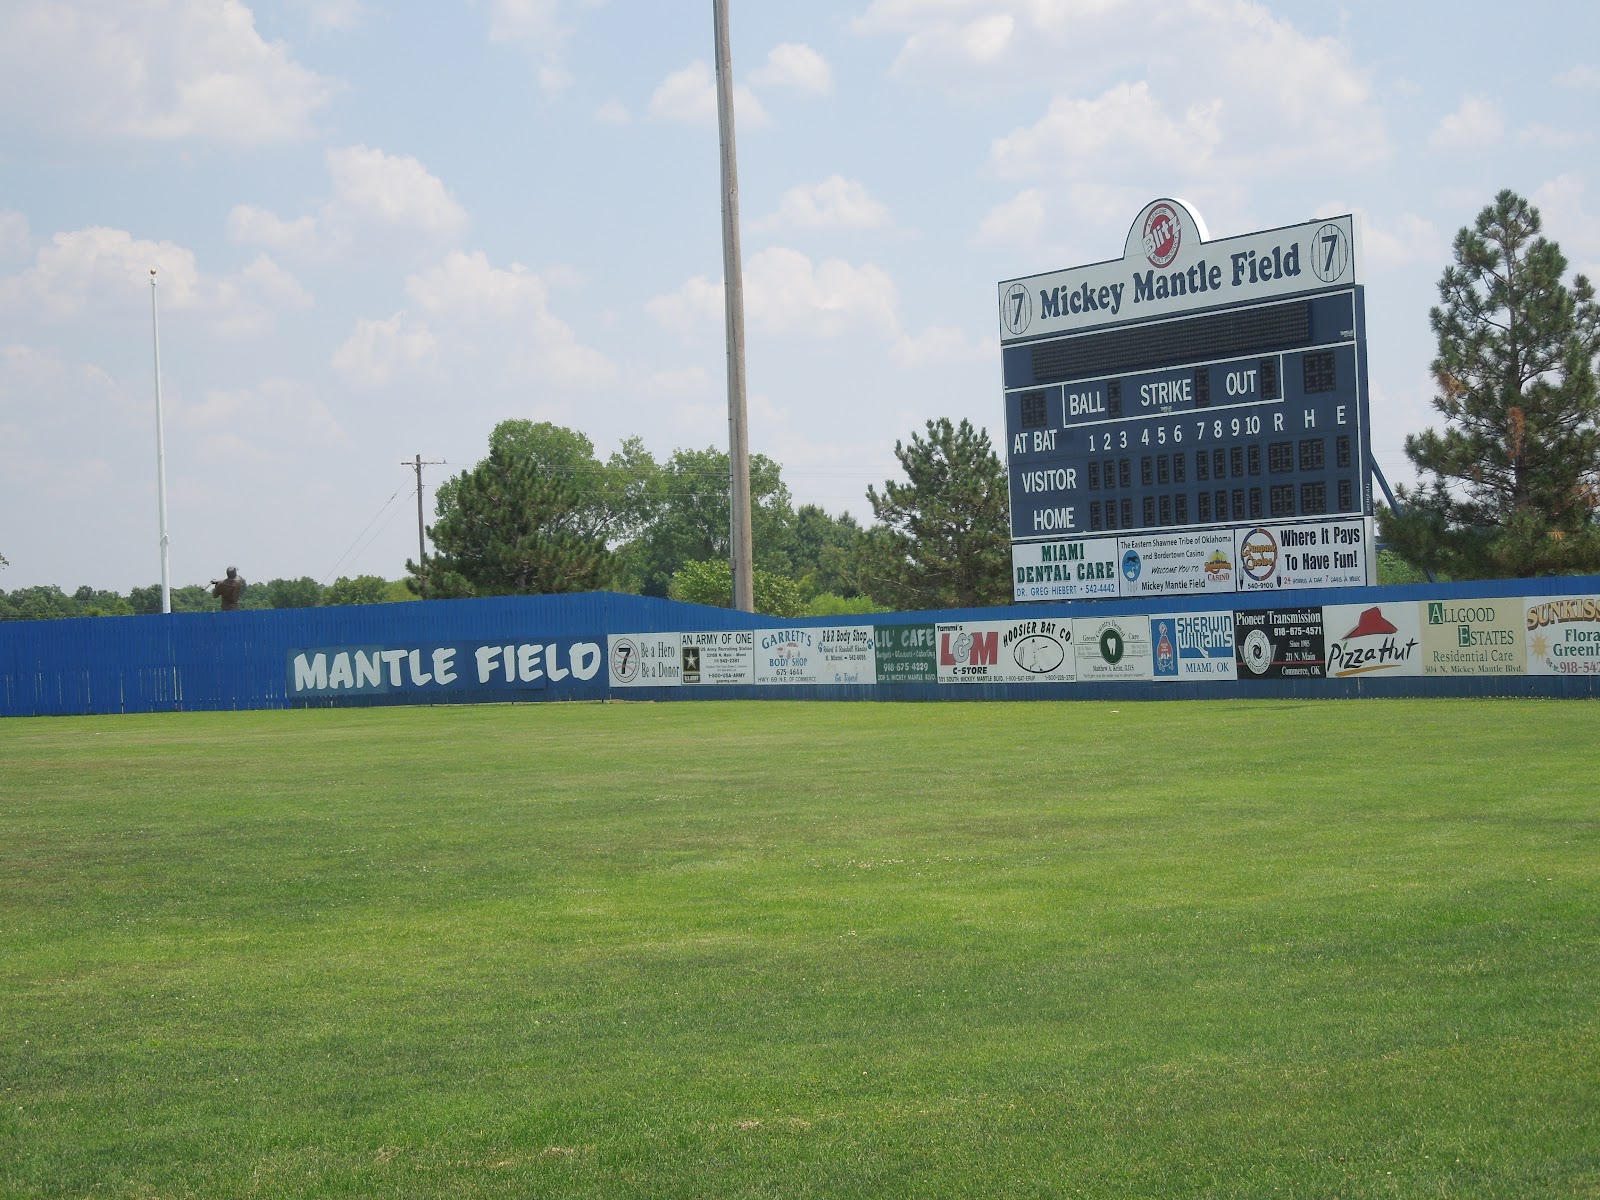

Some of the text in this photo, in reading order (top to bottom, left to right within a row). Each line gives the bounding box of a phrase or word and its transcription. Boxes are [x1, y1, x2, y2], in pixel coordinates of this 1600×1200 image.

[1142, 216, 1181, 257] Blitz
[1321, 234, 1338, 272] 7
[1040, 242, 1301, 320] Mickey Mantle Field
[1011, 292, 1024, 326] 7
[1226, 370, 1256, 395] OUT
[1141, 379, 1192, 407] STRIKE
[1070, 391, 1106, 416] BALL
[1089, 406, 1346, 452] 1 2 3 4 5 6 7 8 9 10 R H E
[1013, 429, 1057, 454] AT BAT
[1022, 468, 1076, 493] VISITOR
[1034, 507, 1075, 530] HOME
[1121, 541, 1131, 549] The
[1152, 539, 1178, 547] Shawnee
[1178, 537, 1194, 546] Tribe
[1194, 536, 1201, 544] of
[1202, 535, 1232, 544] Oklahoma
[1281, 526, 1360, 547] Where It Pays
[1041, 543, 1085, 562] MIAMI
[1142, 550, 1205, 560] and Bordertown Casino
[1285, 550, 1358, 571] To Have Fun!
[1017, 562, 1115, 584] DENTAL CARE
[1207, 573, 1230, 581] CASINO
[1017, 584, 1115, 597] DR. GREG HIEBERT 542-4442
[1141, 579, 1206, 591] Mickey Mantle Field
[1236, 610, 1321, 626] Pioneer Transmission
[1429, 603, 1495, 624] ALLGOOD
[1177, 615, 1232, 633] SHERWIN
[1274, 627, 1322, 636] 918-675-4571
[682, 633, 752, 645] AN ARMY OF ONE
[762, 630, 812, 650] GARRETT'S
[822, 629, 868, 644] R&R Body Shop
[875, 629, 935, 648] LIL' CAFE
[1002, 621, 1073, 648] HOOSIER BAT CO.
[1289, 640, 1300, 648] Since
[1459, 625, 1514, 646] ESTATES
[641, 642, 675, 658] Be a Hero
[940, 632, 999, 666] L&M
[1294, 652, 1300, 661] N.
[1301, 652, 1316, 661] Main
[1327, 636, 1420, 672] Pizza Hut
[1433, 650, 1514, 662] Residential Care
[294, 642, 601, 692] MANTLE FIELD
[618, 647, 631, 674] 7
[641, 662, 680, 677] Be a Donor
[769, 658, 808, 667] BODY SHOP
[1185, 662, 1230, 674] MIAMI, OK
[1450, 666, 1475, 674] Mickey
[1478, 665, 1503, 673] Mantle
[1505, 664, 1524, 673] Blvd.
[952, 667, 988, 675] C-STORE
[1282, 665, 1321, 676] Commerce, OK
